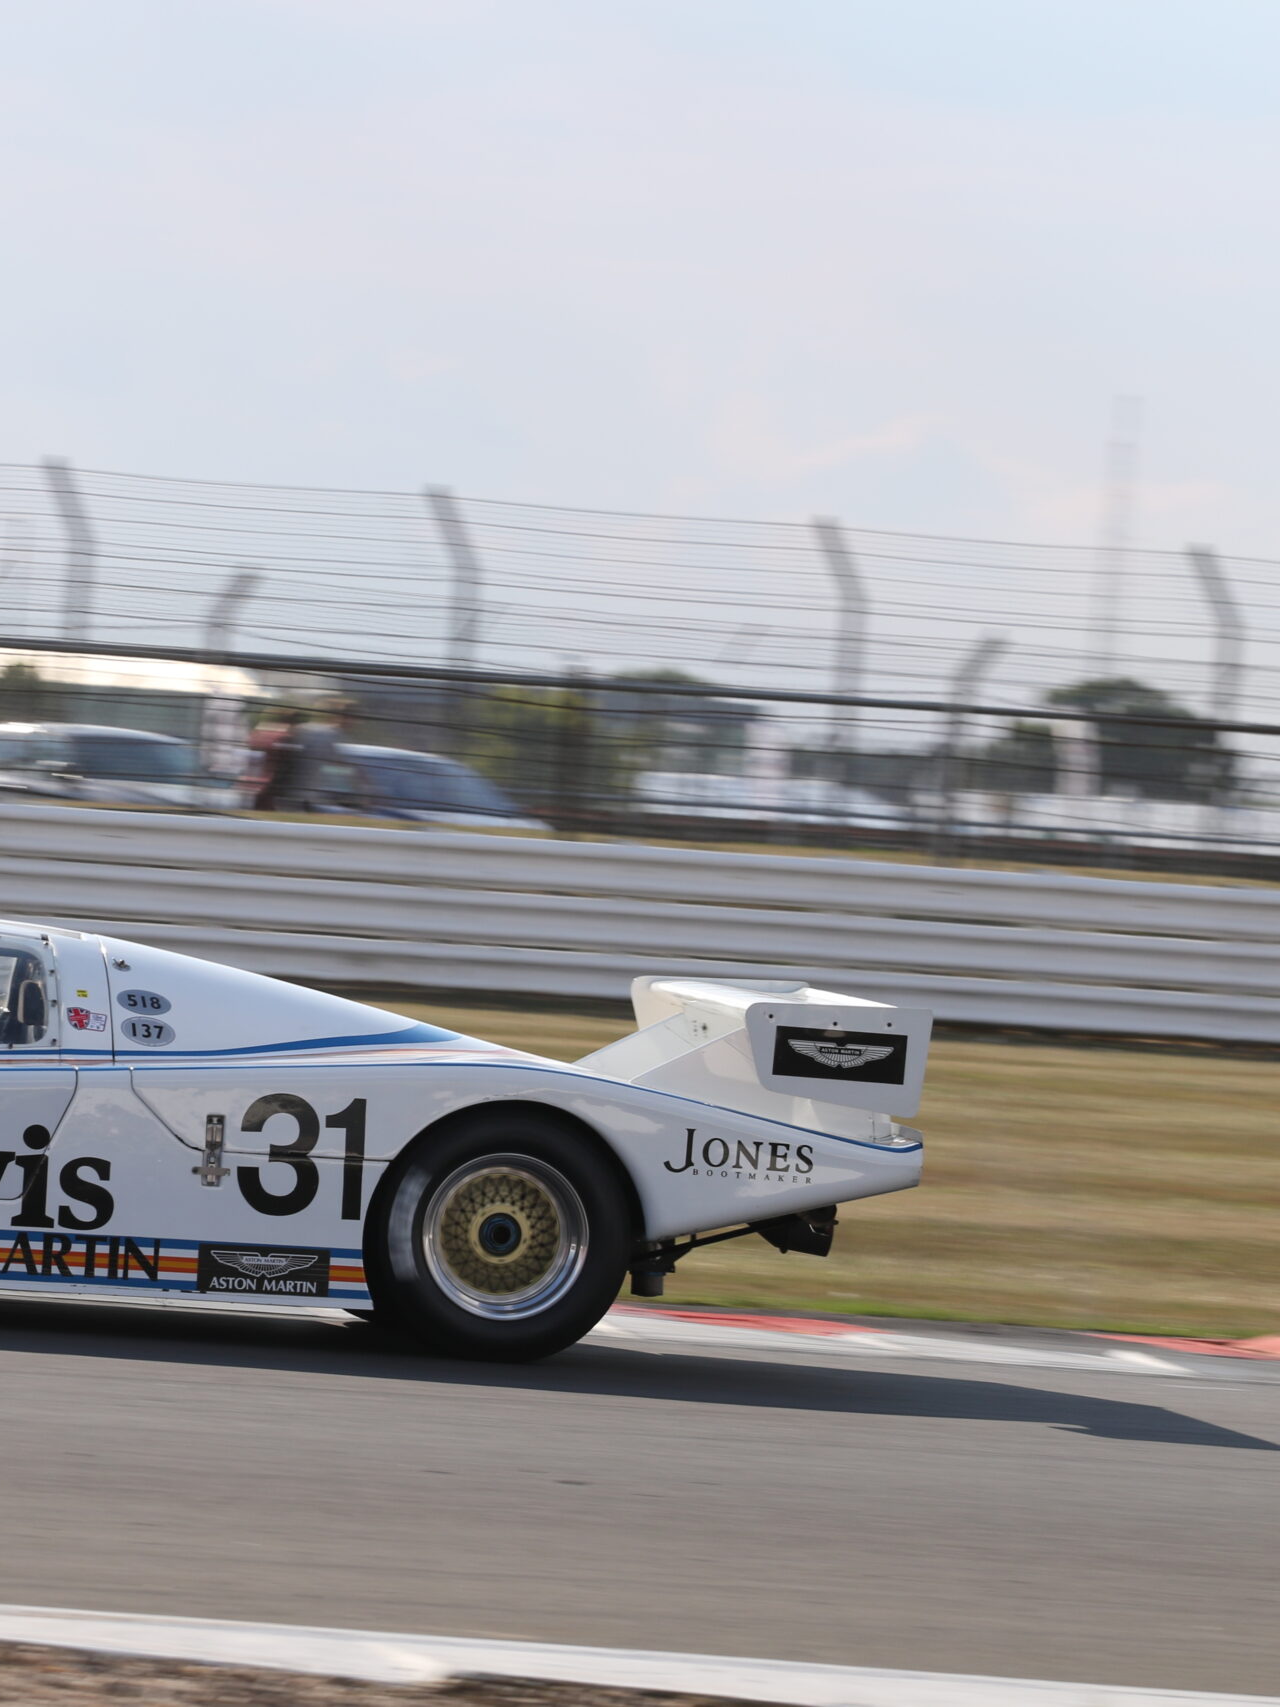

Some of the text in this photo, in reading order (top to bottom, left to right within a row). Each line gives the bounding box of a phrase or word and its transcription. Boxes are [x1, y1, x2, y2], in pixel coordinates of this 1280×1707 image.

[127, 994, 162, 1010] 518
[131, 1022, 164, 1039] 137
[236, 1092, 368, 1221] 31
[663, 1128, 814, 1174] JONES
[692, 1168, 812, 1184] BOOTMAKER
[209, 1276, 317, 1293] ASTON MARTIN
